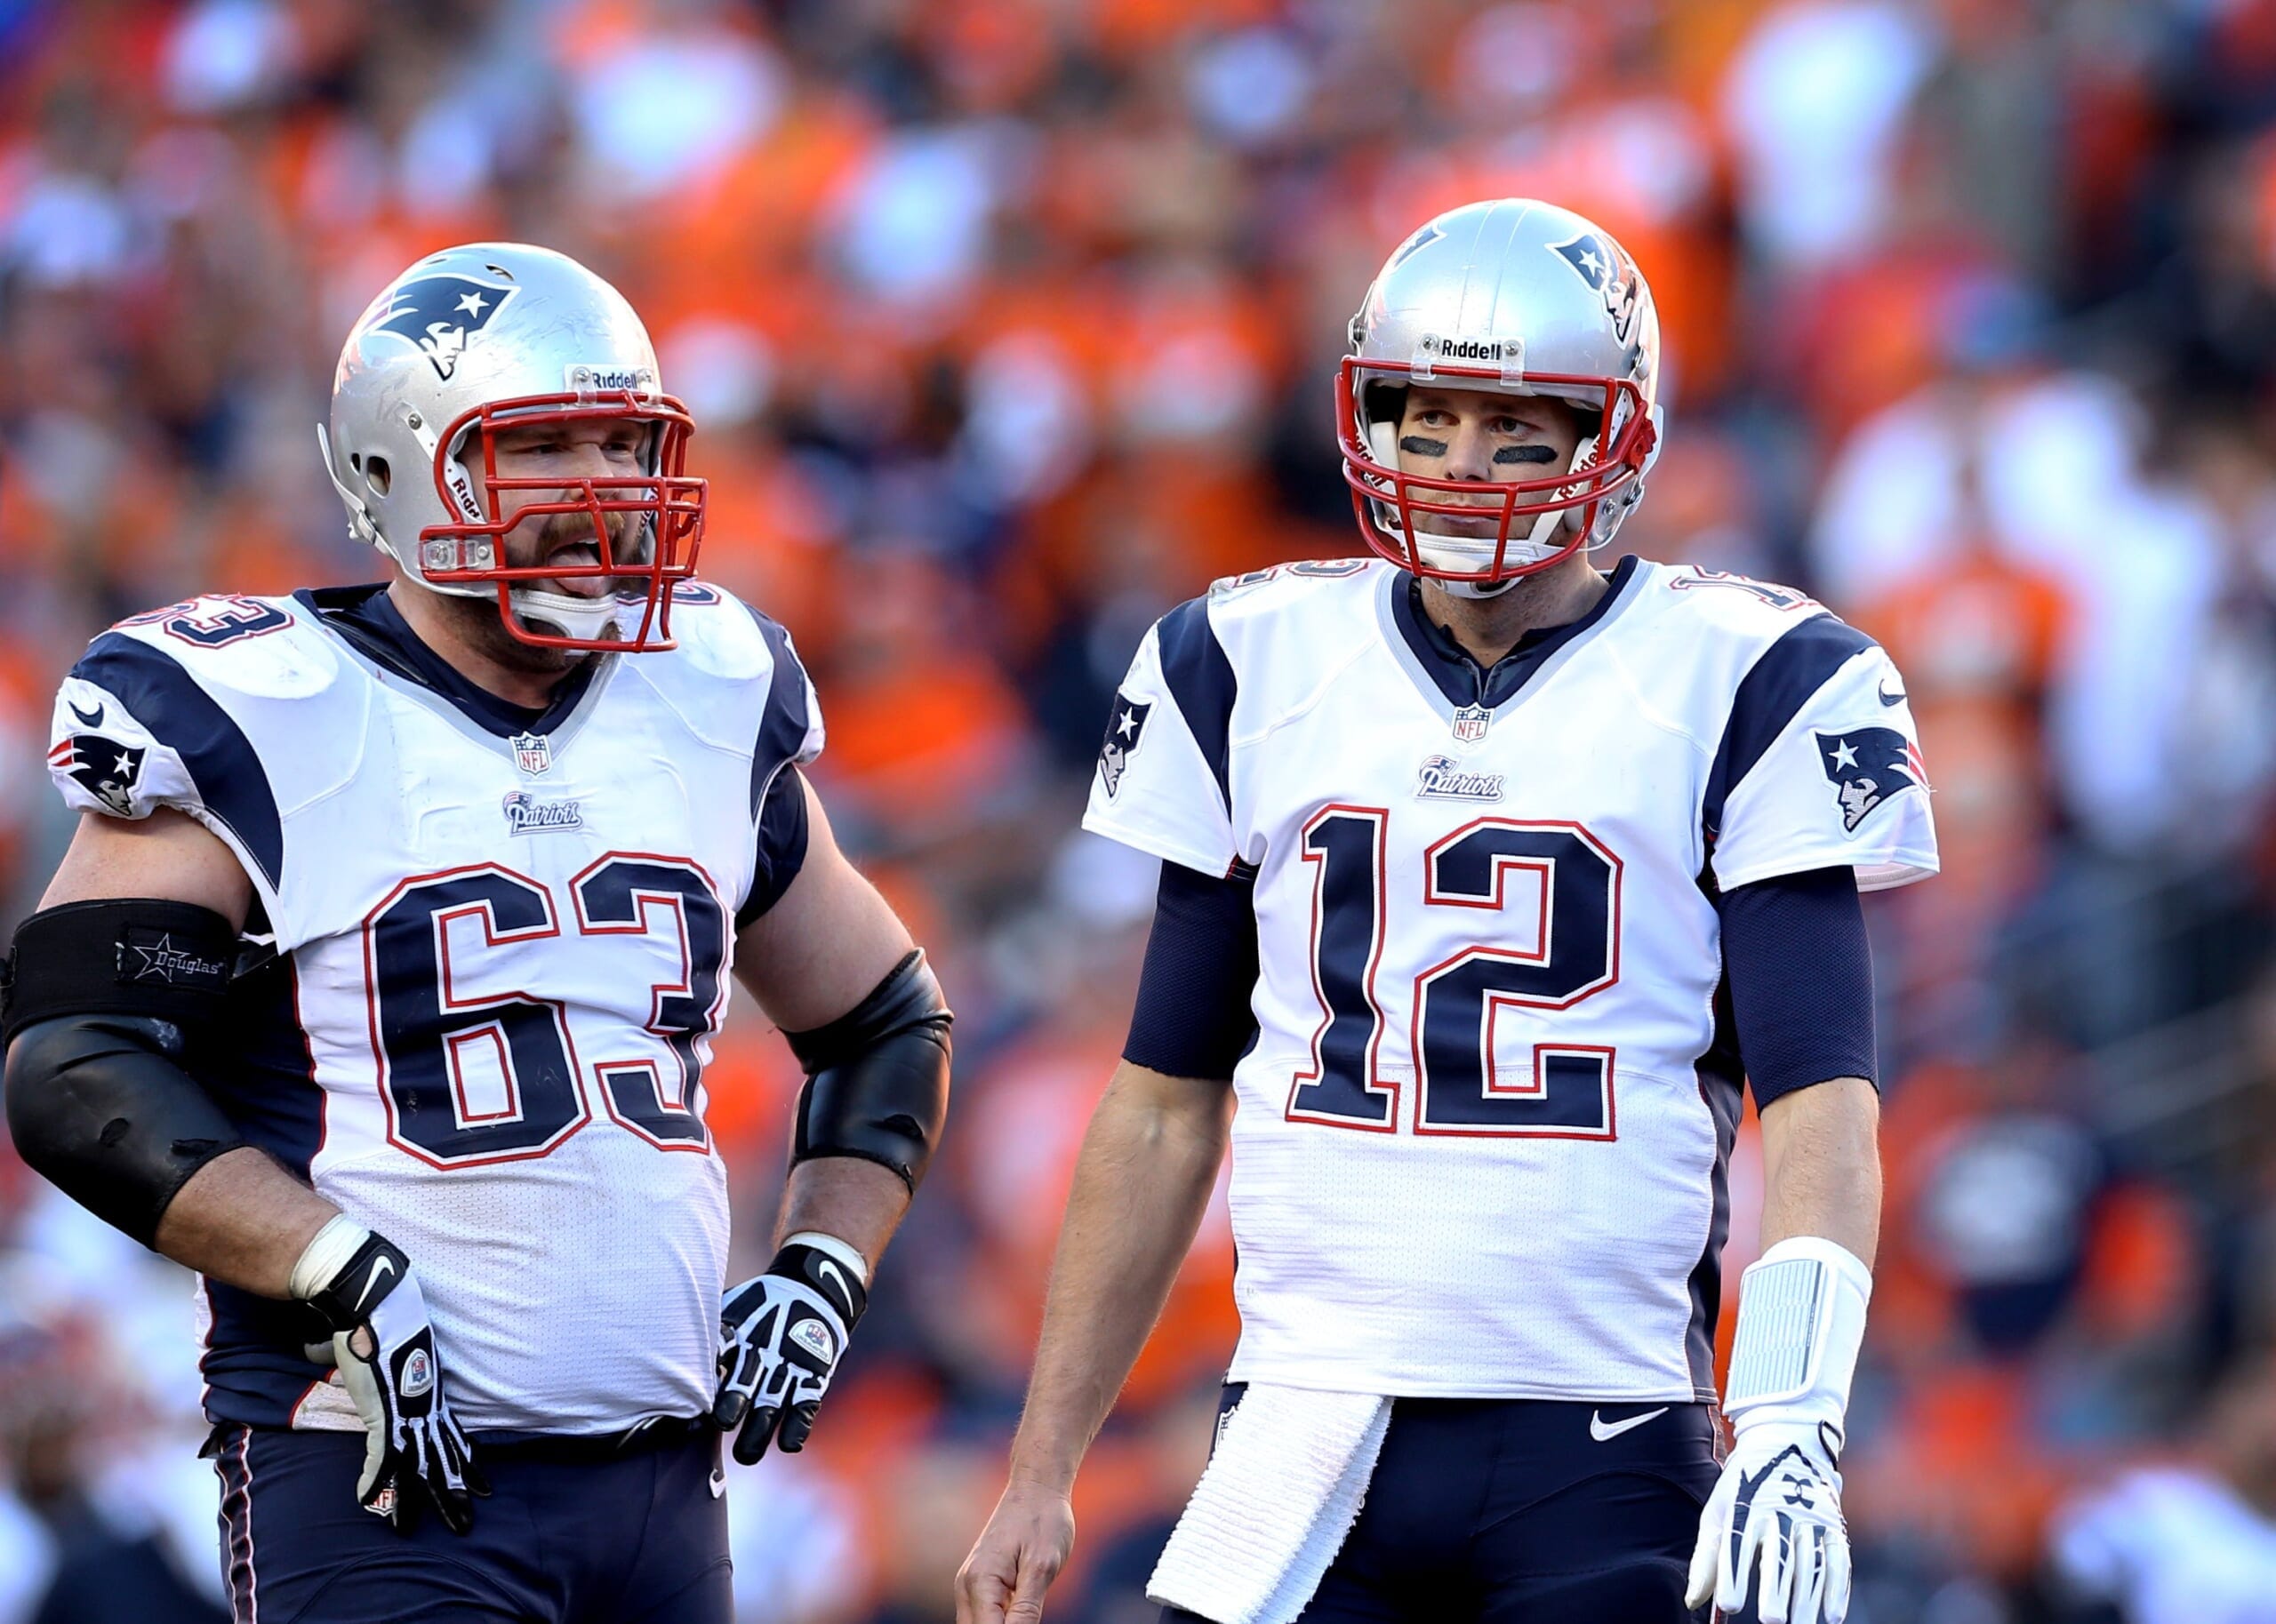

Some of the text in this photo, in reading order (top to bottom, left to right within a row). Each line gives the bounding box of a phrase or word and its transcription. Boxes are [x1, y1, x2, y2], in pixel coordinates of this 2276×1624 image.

[1441, 339, 1501, 360] Riddell
[591, 370, 637, 389] Riddell
[452, 477, 481, 519] Ridd
[1456, 721, 1484, 740] NFL
[520, 751, 548, 772] NFL
[1418, 766, 1503, 802] Patriots
[506, 801, 583, 835] Patriots
[154, 951, 219, 974] Douglas
[1285, 804, 1623, 1141] 12
[362, 851, 729, 1171] 63
